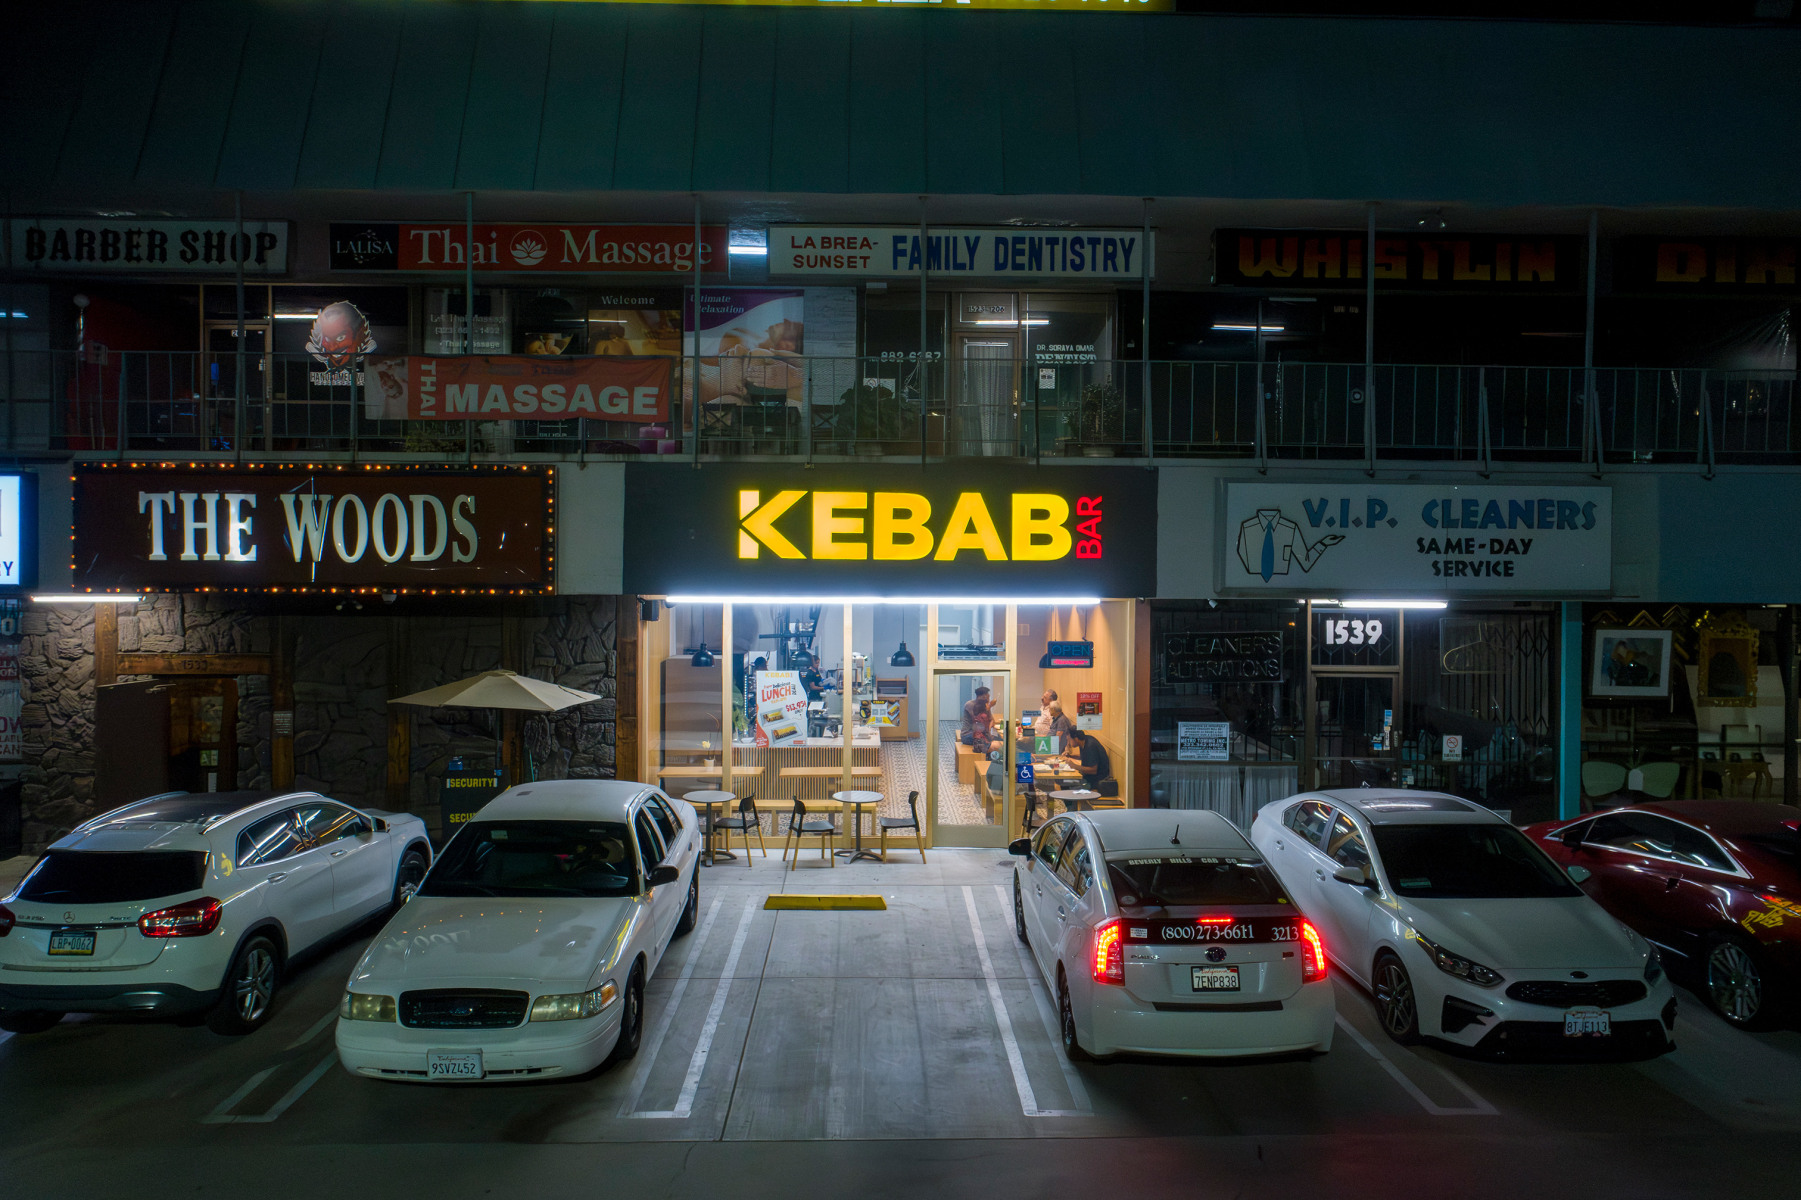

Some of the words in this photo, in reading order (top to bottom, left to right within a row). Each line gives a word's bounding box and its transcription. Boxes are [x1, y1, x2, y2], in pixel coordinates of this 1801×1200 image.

[25, 226, 168, 263] BARBER
[179, 229, 278, 265] SHOP
[336, 240, 393, 255] LALISA
[410, 229, 500, 265] Thai
[560, 228, 712, 272] Massage
[791, 236, 816, 250] LA
[793, 254, 871, 269] SUNSET
[892, 235, 981, 271] FAMILY
[994, 236, 1136, 273] DENTISTRY
[1238, 235, 1556, 282] WHISTLIN
[601, 295, 655, 305] Welcome
[700, 304, 744, 313] elaxation
[1035, 353, 1097, 365] DENTIST
[419, 360, 436, 417] THAI
[445, 384, 658, 416] MASSAGE
[1302, 498, 1399, 529] V.I.P.
[1421, 499, 1599, 531] CLEANERS
[138, 492, 258, 563] THE
[280, 493, 480, 565] WOODS
[738, 490, 1073, 562] KEBAB
[1076, 495, 1103, 559] BAR
[1416, 536, 1533, 556] SAME-DAY
[1432, 560, 1515, 578] SERVICE
[1325, 619, 1383, 646] 1539
[1052, 644, 1090, 657] OPEN
[1168, 635, 1281, 656] CLEANERS
[1168, 658, 1281, 679] ALTERATIONS
[761, 684, 792, 703] LUNCH
[1038, 740, 1049, 752] A
[450, 778, 494, 788] SECURITY
[1271, 926, 1300, 941] 3213
[1194, 975, 1237, 988] 7ENP838
[431, 1062, 476, 1074] 9SVZ452
